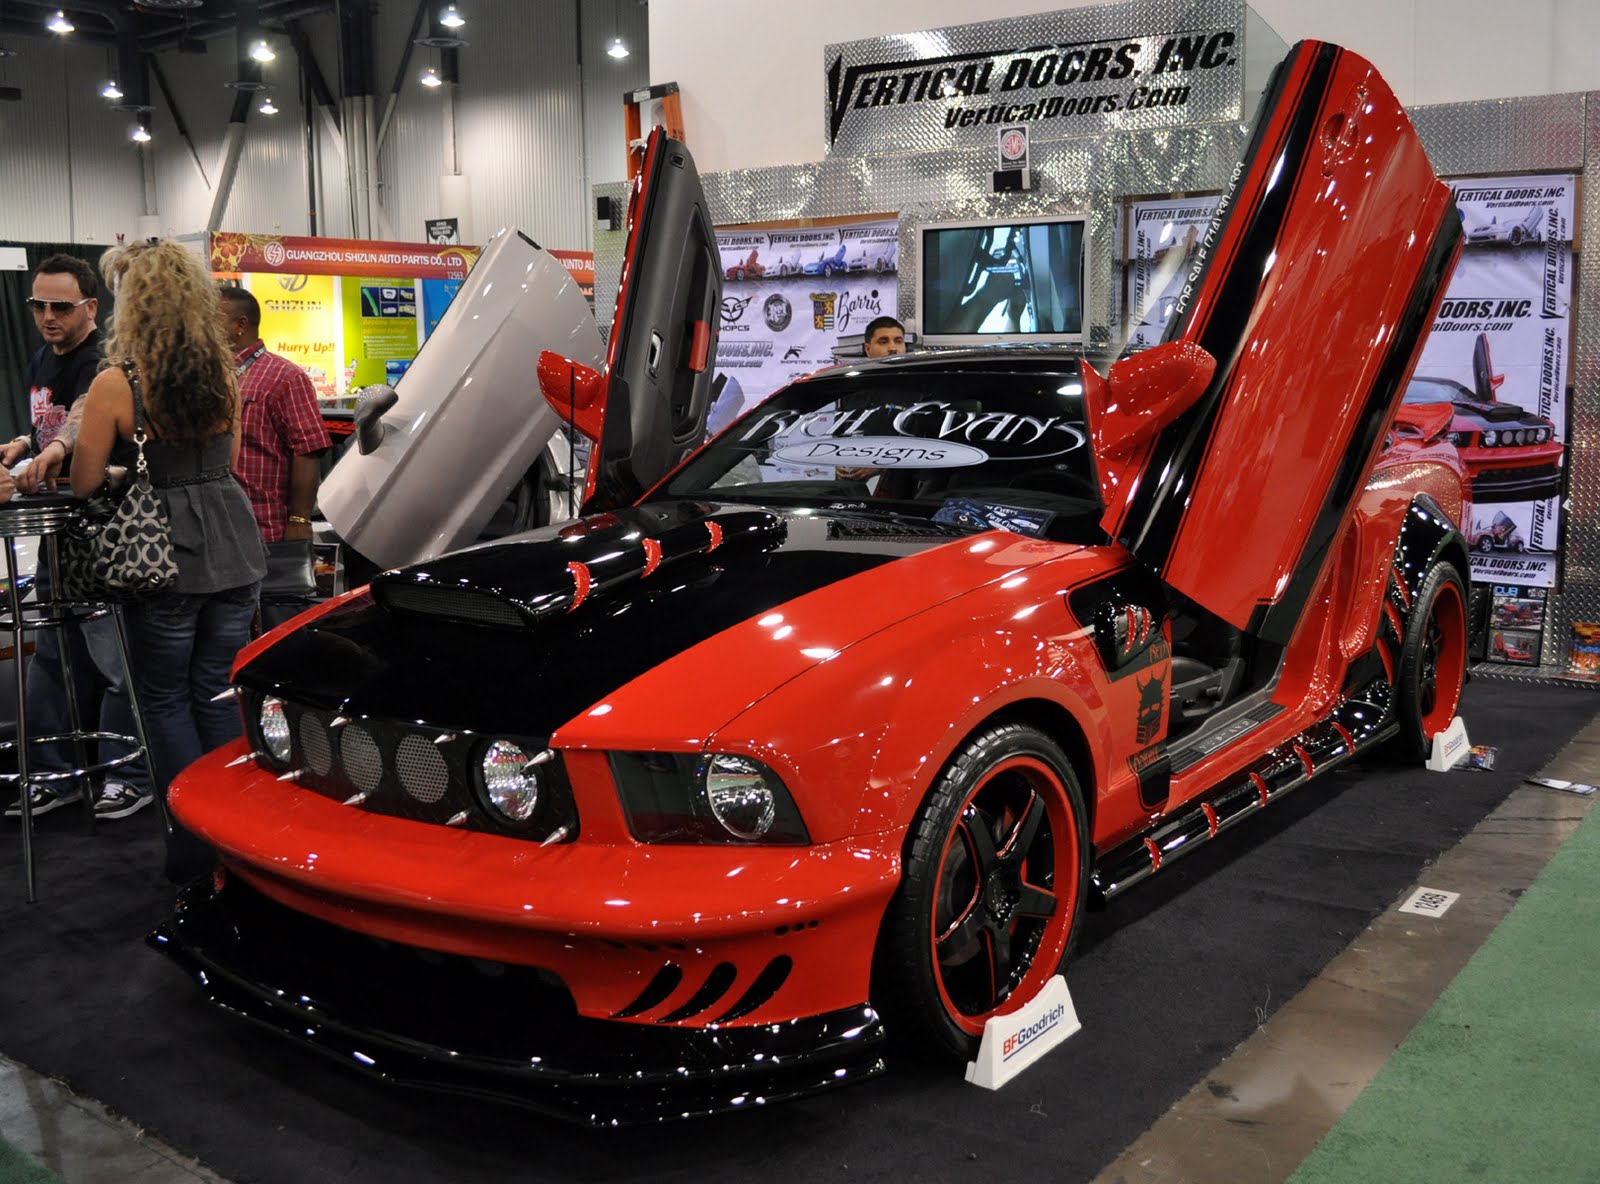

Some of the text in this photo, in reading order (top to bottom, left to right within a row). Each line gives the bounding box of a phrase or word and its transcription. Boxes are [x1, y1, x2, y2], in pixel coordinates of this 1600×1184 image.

[828, 53, 994, 148] VERTICAL
[1151, 31, 1237, 74] INC.
[945, 86, 1191, 128] VerticalDoors.Com
[1451, 184, 1502, 204] VERTICAL
[1135, 207, 1177, 229] VERTICAL
[286, 250, 344, 262] GUANGZHOU
[345, 252, 377, 263] SHIZUN
[378, 254, 401, 265] AUTO
[402, 255, 429, 266] PARTS
[447, 257, 462, 267] LTD
[837, 289, 882, 332] Barris
[1176, 285, 1194, 314] FOR
[277, 342, 335, 355] Hurry Up!!
[805, 442, 949, 466] Designs
[1413, 892, 1448, 911] 12459
[1003, 1004, 1065, 1056] BFGoodrich
